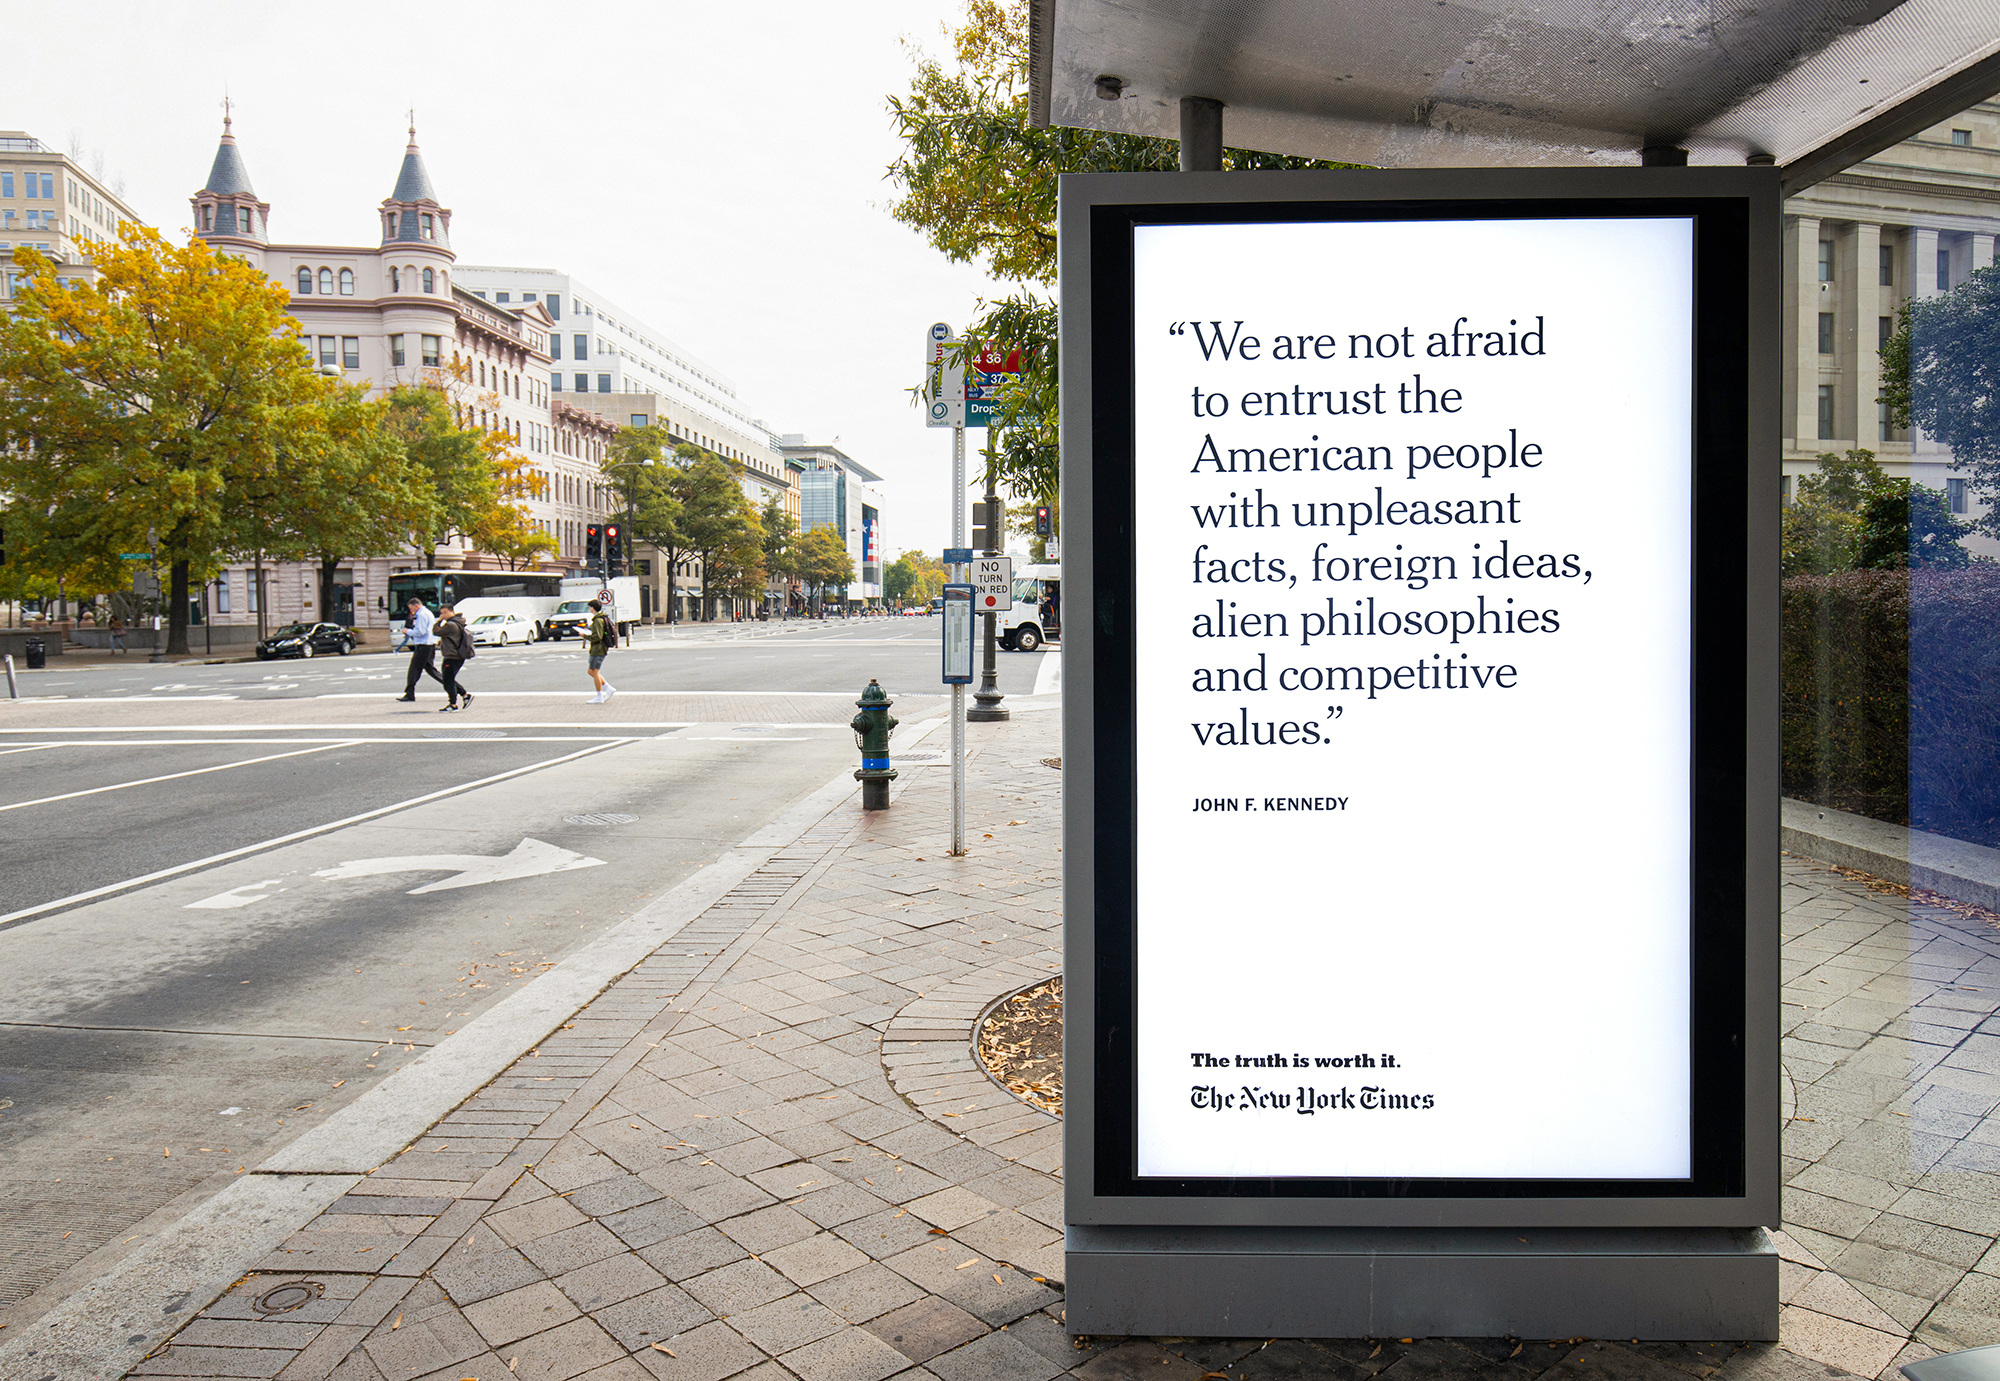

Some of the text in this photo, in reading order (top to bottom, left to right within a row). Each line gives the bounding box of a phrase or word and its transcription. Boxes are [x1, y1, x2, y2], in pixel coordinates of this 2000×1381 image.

[1273, 335, 1336, 360] are
[1348, 327, 1415, 359] not
[1426, 315, 1547, 358] afraid
[986, 354, 1001, 364] 36
[990, 374, 1002, 384] 37
[1191, 374, 1463, 418] to entrust the
[1190, 428, 1543, 480] American people
[1190, 486, 1522, 536] with unpleasant
[979, 574, 1003, 583] TURN
[981, 561, 999, 572] NO
[1192, 539, 1592, 590] facts, foreign ideas,
[990, 585, 1008, 594] RED
[1192, 595, 1560, 647] alien philosophies
[1192, 652, 1518, 700] and competitive
[1192, 797, 1349, 812] JOHN F. KENNEDY
[1190, 1052, 1401, 1068] The truth is worth it.
[1190, 1085, 1435, 1116] The New York Times
